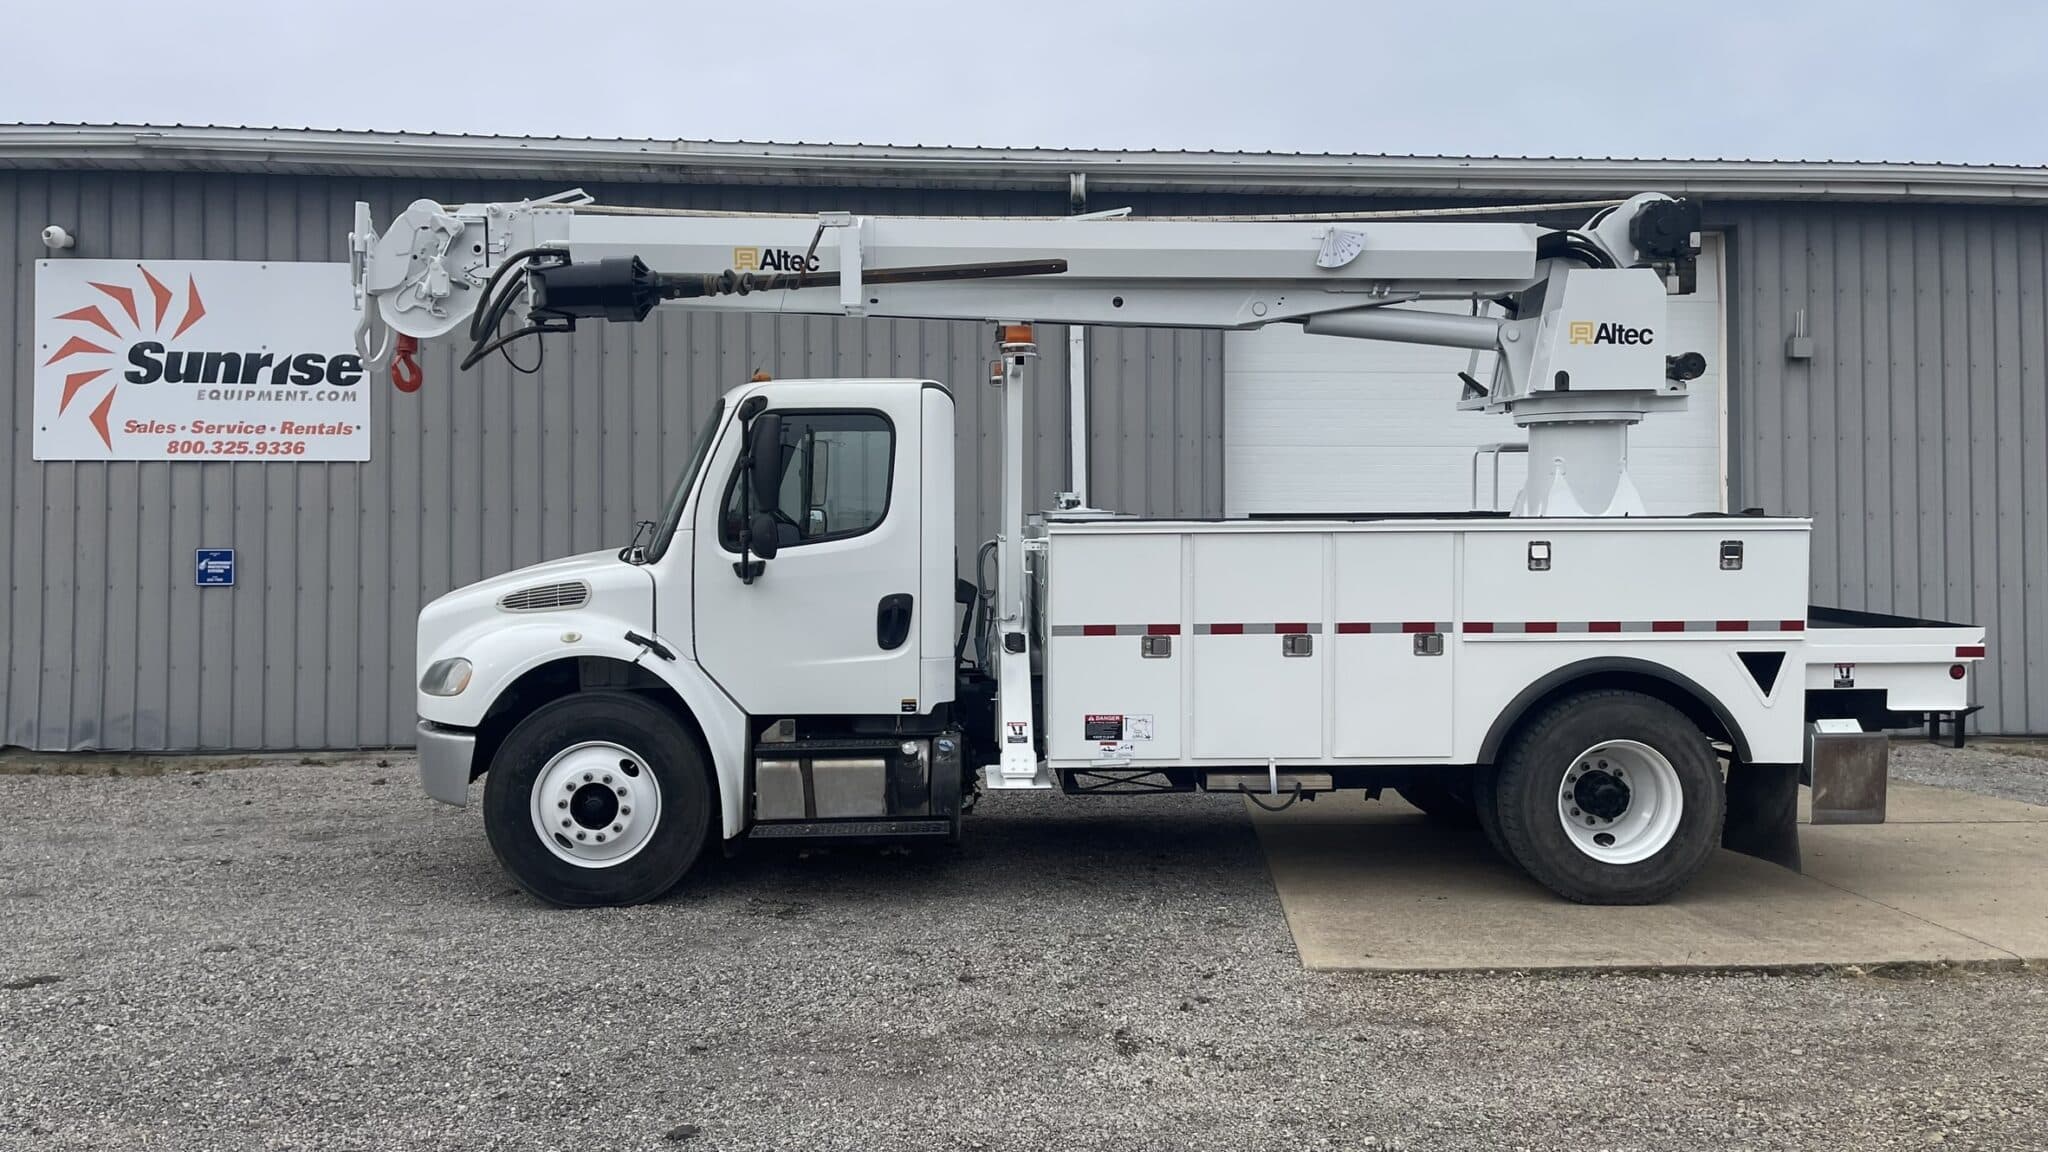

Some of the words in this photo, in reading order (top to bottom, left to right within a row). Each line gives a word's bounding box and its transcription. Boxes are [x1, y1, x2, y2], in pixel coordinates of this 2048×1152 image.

[759, 248, 820, 271] Altec
[1594, 322, 1654, 345] Altec
[124, 341, 364, 387] Sunrise
[196, 389, 357, 402] EQUIPMENT.COM
[124, 420, 177, 434] Sales
[191, 420, 267, 435] Service
[280, 421, 353, 436] Rentals
[166, 440, 306, 455] 800.325.9336
